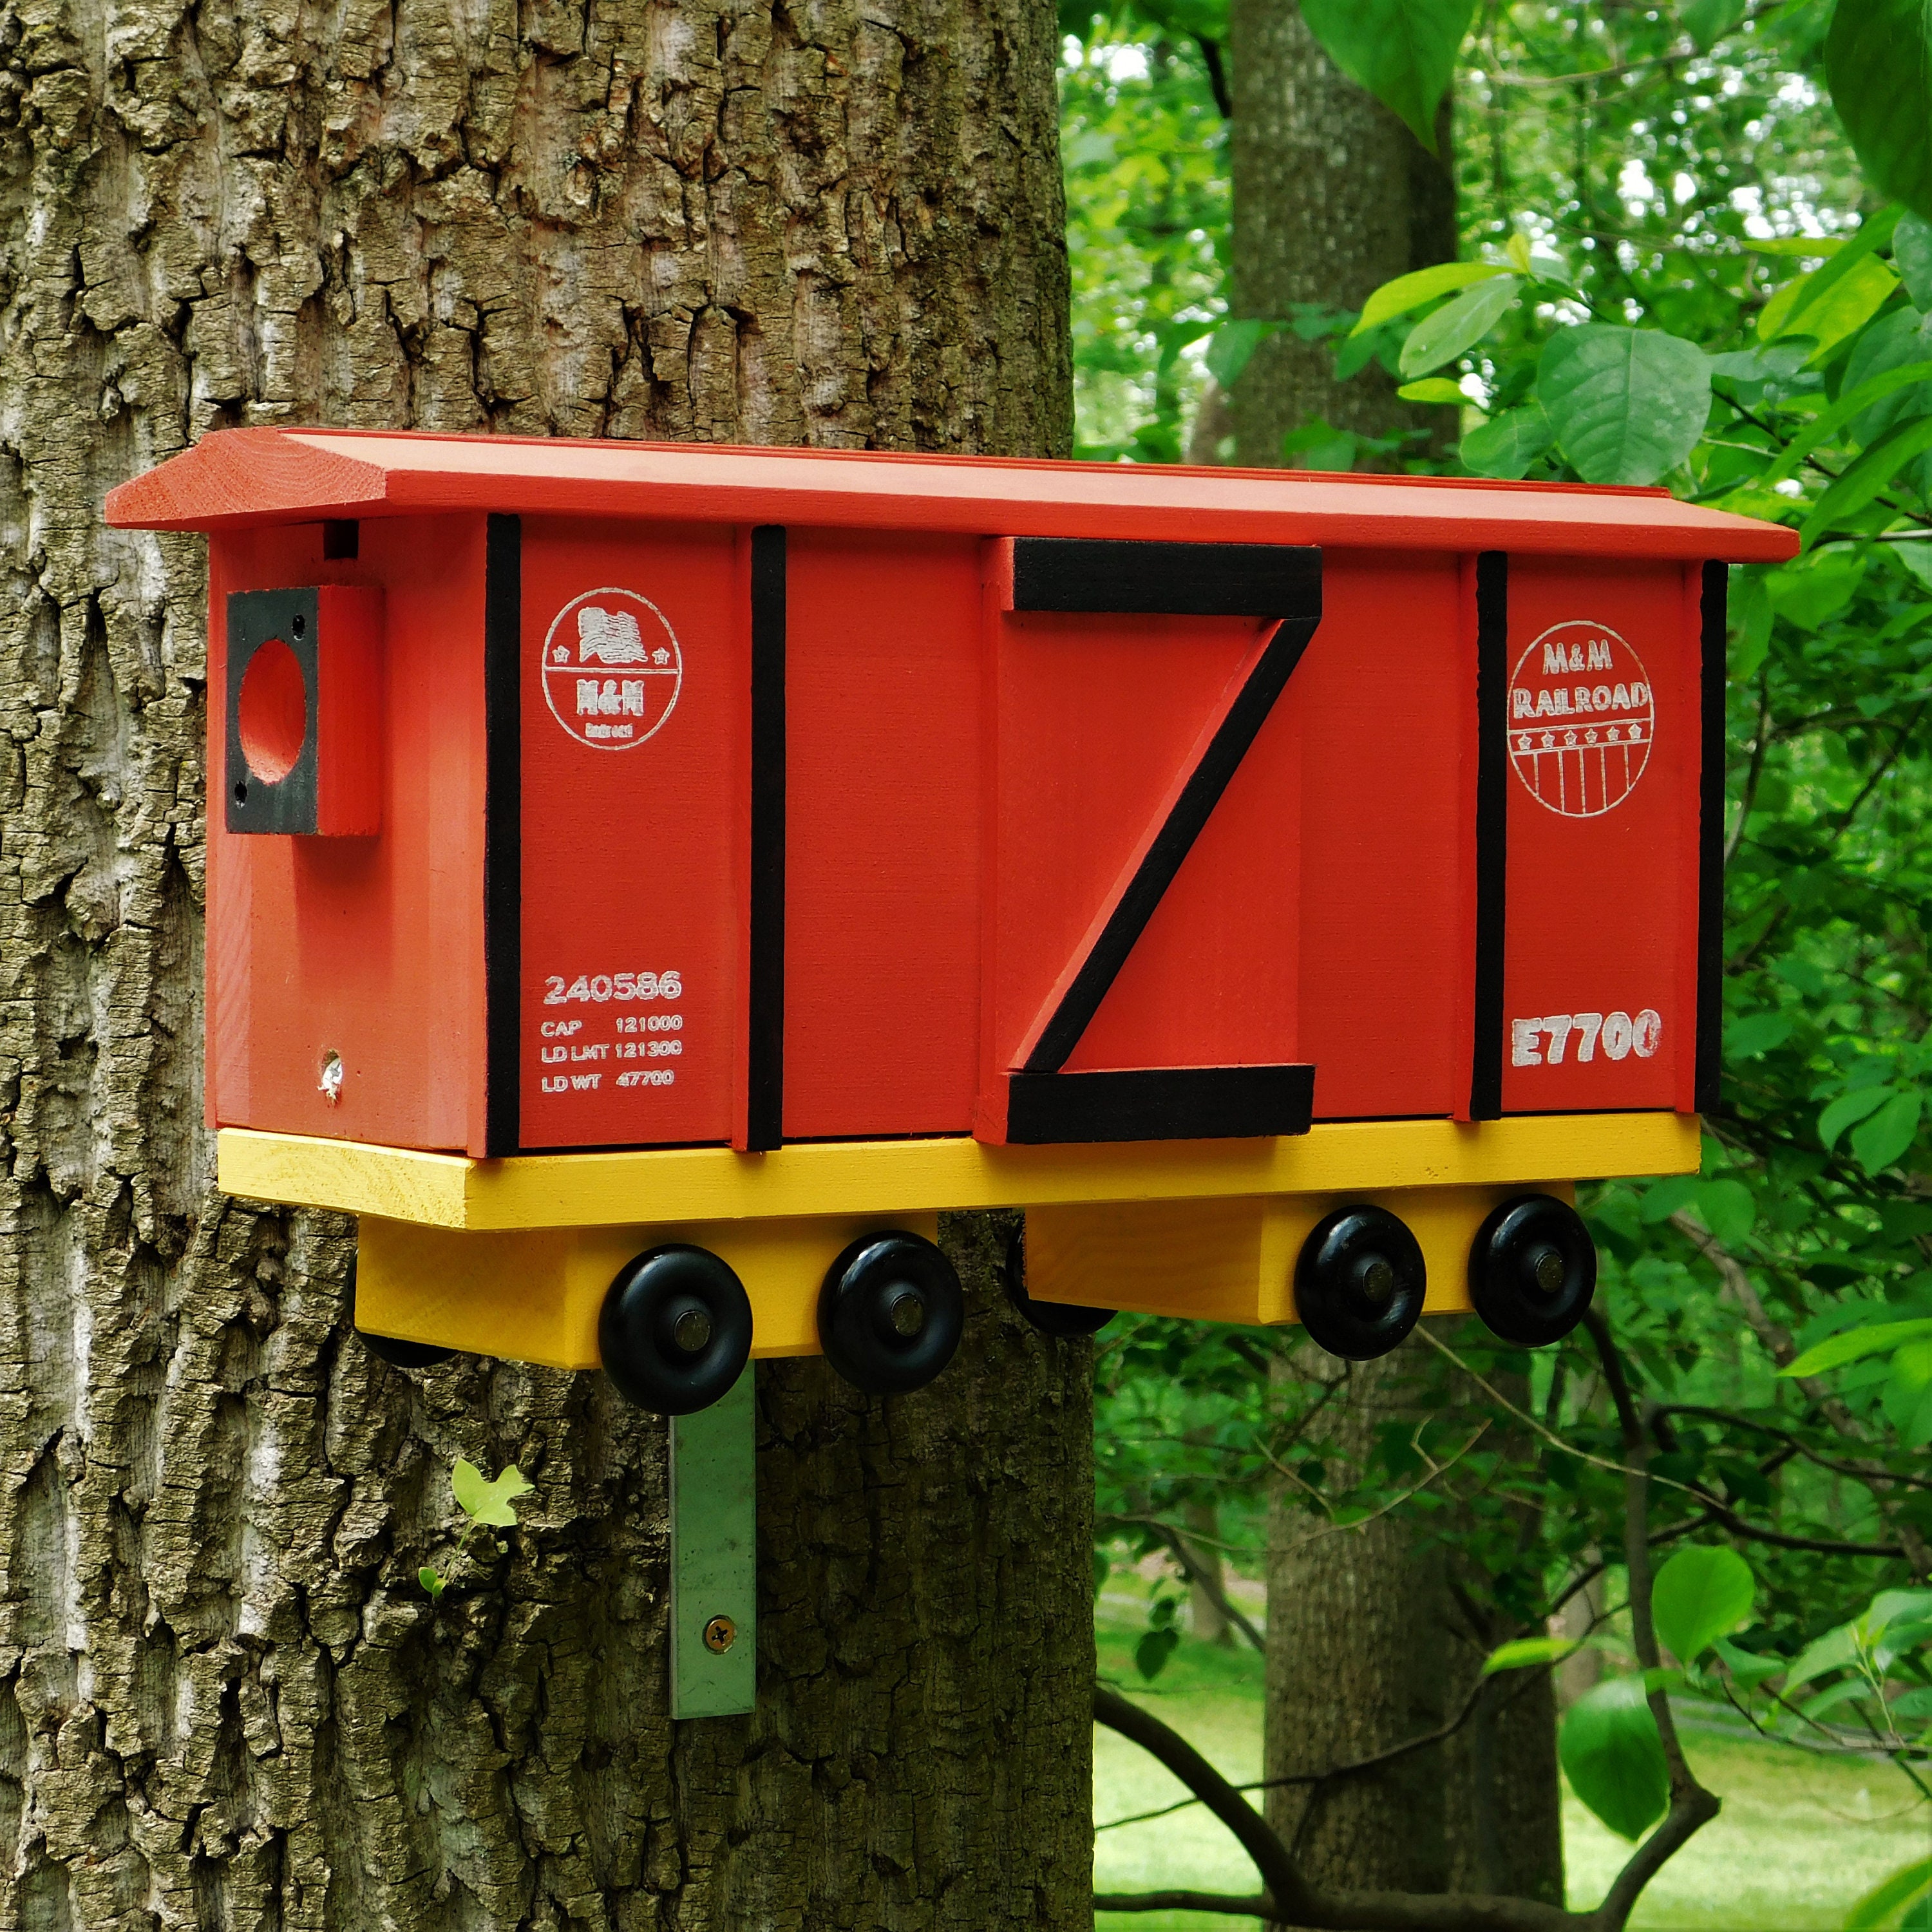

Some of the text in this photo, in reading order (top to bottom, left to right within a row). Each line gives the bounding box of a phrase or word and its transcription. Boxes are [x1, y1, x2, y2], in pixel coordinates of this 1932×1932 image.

[1542, 639, 1614, 675] M&M
[1512, 681, 1650, 719] RAILROAD
[543, 970, 682, 1005] 240586
[540, 1014, 683, 1037] CAP 121000
[1511, 1009, 1662, 1067] E7700
[541, 1039, 683, 1063] LD LMT 121300
[541, 1069, 674, 1093] LD WT 47700
